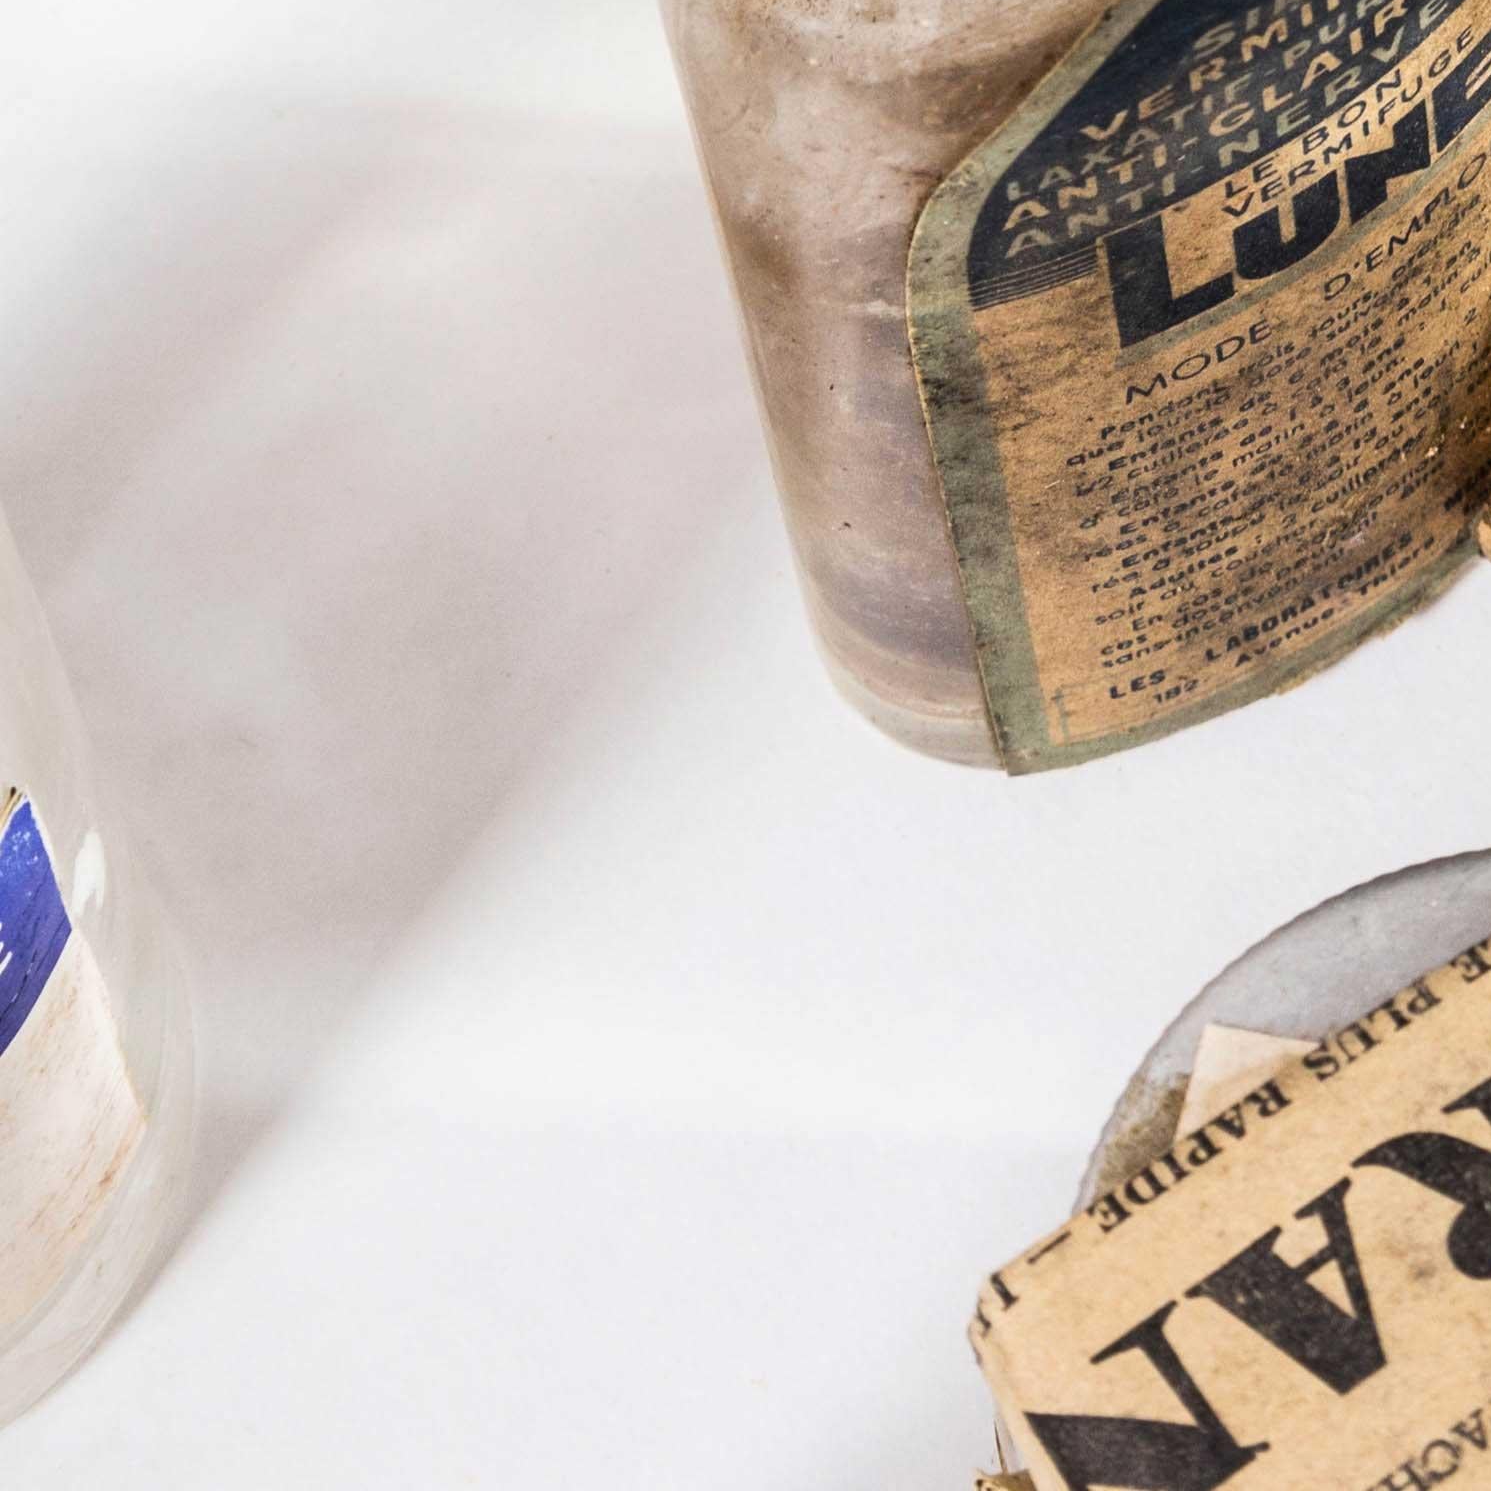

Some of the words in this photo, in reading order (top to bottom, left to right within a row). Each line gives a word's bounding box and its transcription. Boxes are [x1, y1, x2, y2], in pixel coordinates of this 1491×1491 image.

[1220, 25, 1475, 218] VERMIFUGE
[1223, 159, 1277, 199] LE
[1301, 72, 1402, 155] BON
[1125, 319, 1273, 406] MODE
[1126, 422, 1249, 479] cuillerée
[1398, 272, 1457, 326] matin
[1100, 379, 1229, 440] Pendant
[1108, 417, 1223, 470] Enfants
[1240, 389, 1272, 412] de
[1111, 450, 1224, 505] Enfants
[1239, 425, 1272, 448] de
[1361, 333, 1405, 374] ans
[1066, 437, 1124, 469] que
[1194, 465, 1218, 485] le
[1231, 423, 1304, 466] matin
[1119, 481, 1235, 536] Enfants
[1121, 516, 1233, 569] Enfants
[1128, 547, 1237, 599] Adultes
[1093, 599, 1145, 631] soir
[1160, 580, 1195, 602] au
[1109, 666, 1167, 704] LES
[1204, 537, 1412, 661] LABORATOIRES
[1130, 609, 1162, 633] En
[1100, 631, 1147, 660] ces
[1233, 608, 1335, 667] Avenue
[1300, 977, 1444, 1082] PLUS
[1085, 1087, 1296, 1234] RAPIDE
